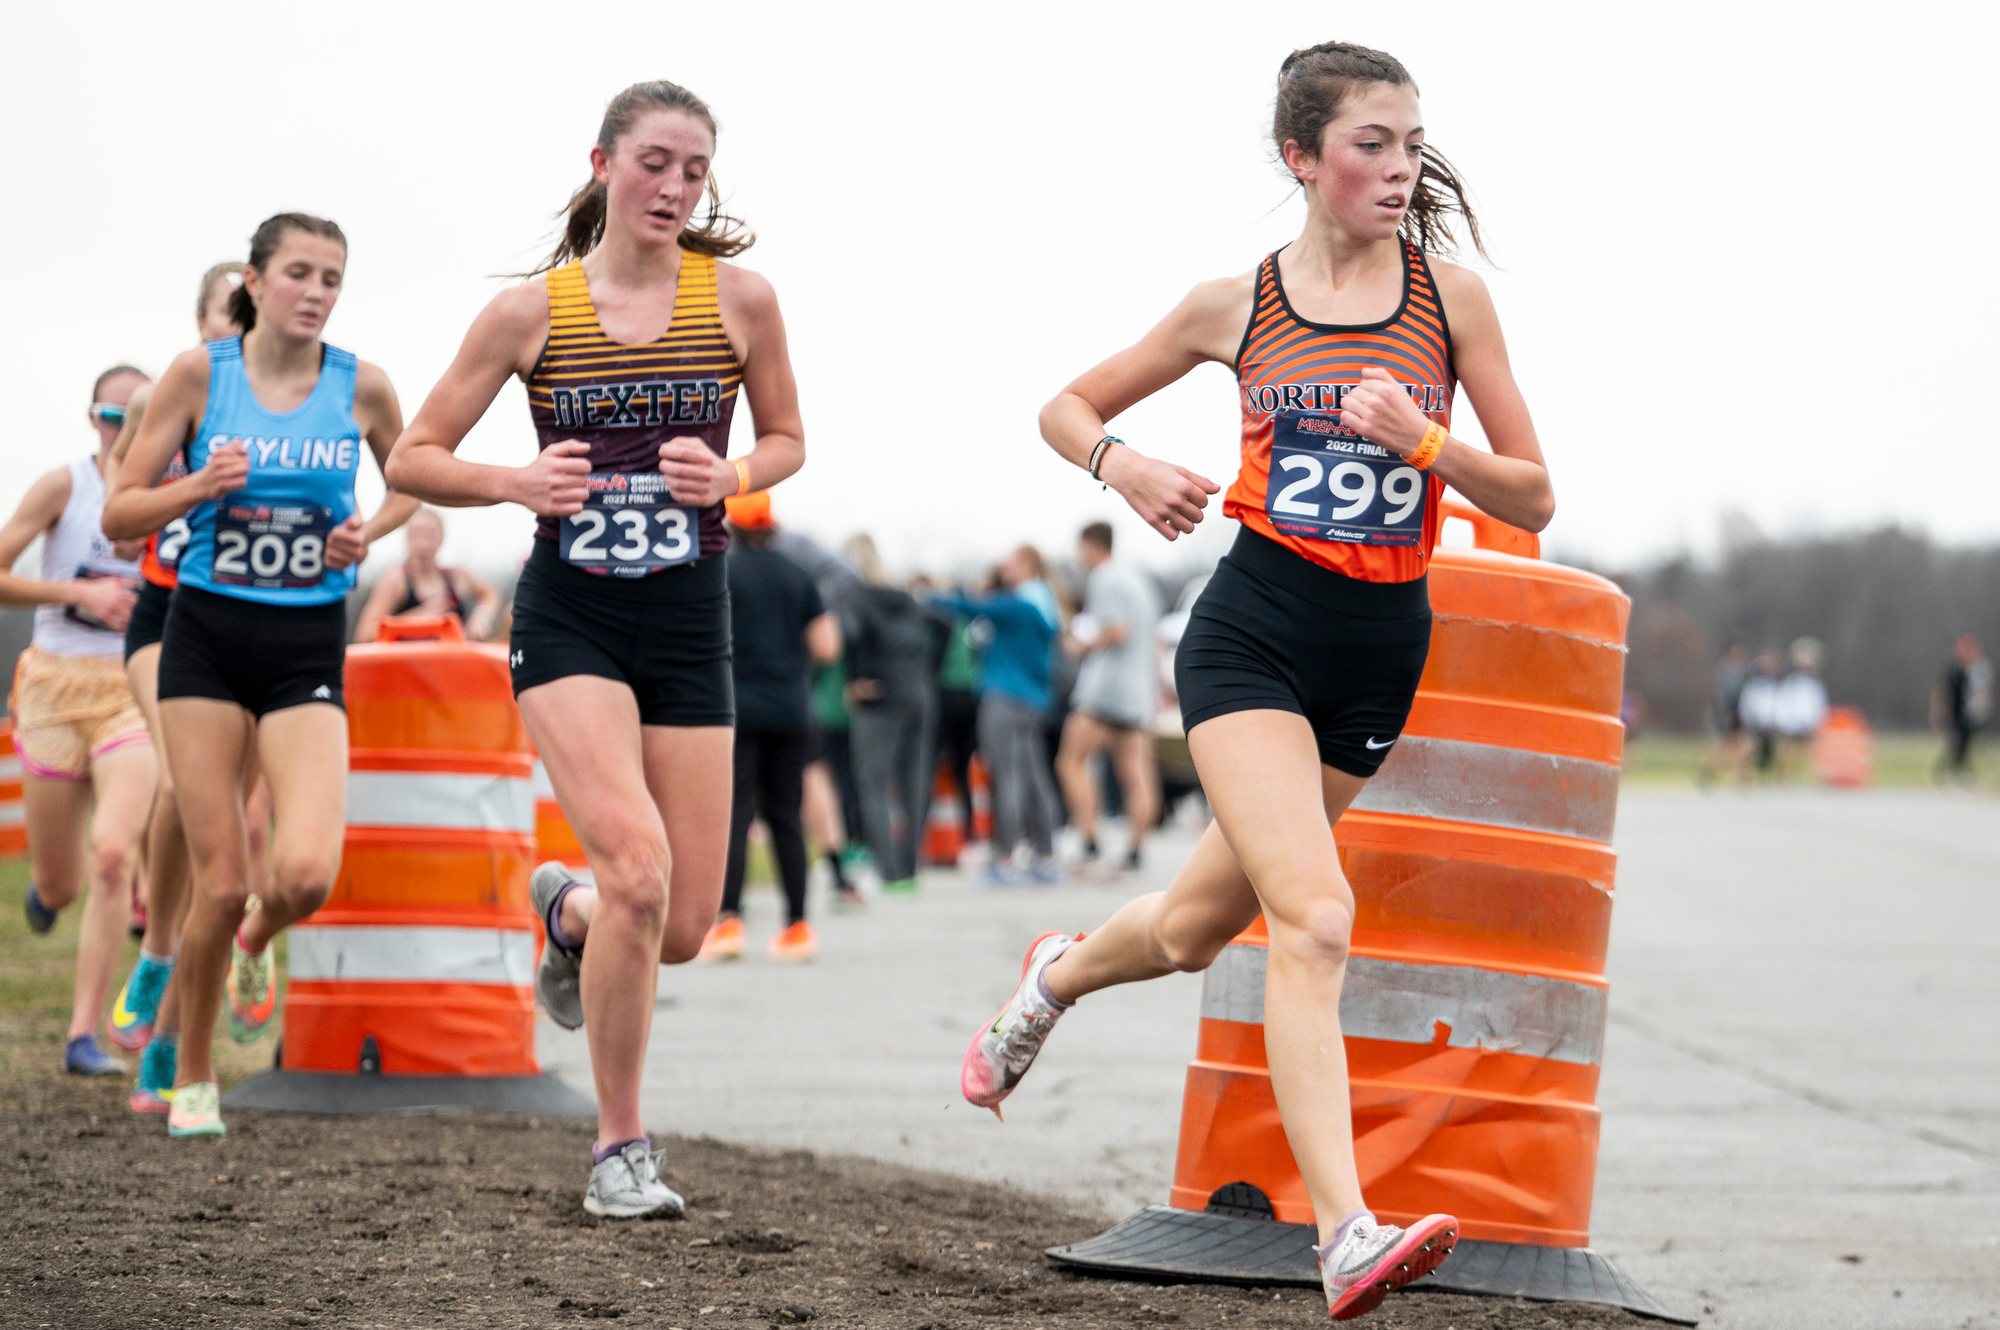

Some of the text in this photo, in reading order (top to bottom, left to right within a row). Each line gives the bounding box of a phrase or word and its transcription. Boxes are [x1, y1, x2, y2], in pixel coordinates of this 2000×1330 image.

[551, 379, 722, 428] DEXTER
[206, 433, 353, 471] SYLINE
[1325, 439, 1389, 457] 2022 FINAL
[602, 493, 655, 505] 2022 FINAL
[630, 484, 671, 493] COUNTR
[1272, 454, 1422, 525] 299
[214, 529, 323, 578] 208
[568, 508, 691, 561] 233
